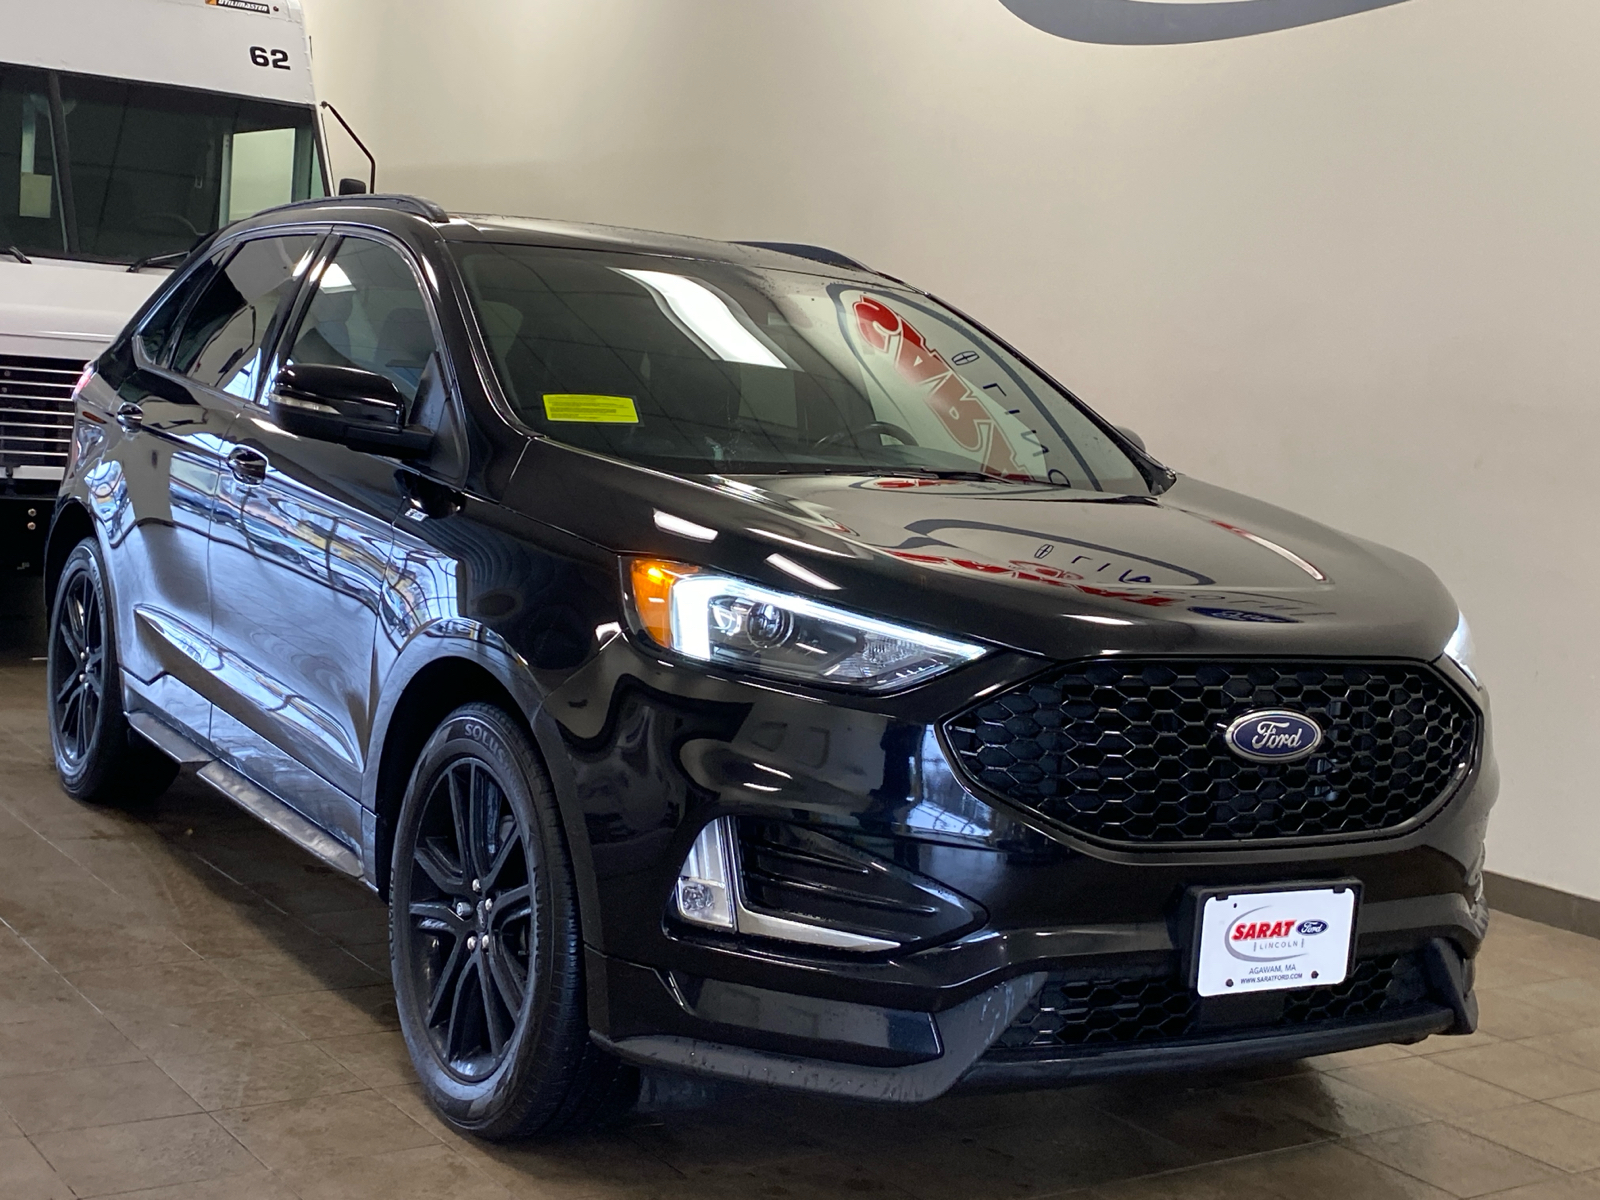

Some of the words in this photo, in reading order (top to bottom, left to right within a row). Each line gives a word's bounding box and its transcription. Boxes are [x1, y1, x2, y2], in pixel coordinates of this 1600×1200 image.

[249, 46, 291, 70] 62
[464, 723, 506, 763] SOLUS
[1251, 721, 1303, 749] Ford
[1231, 920, 1297, 942] SARAT
[1300, 921, 1324, 934] Ford
[1259, 941, 1298, 950] LINCOLN
[1240, 973, 1303, 984] WWW.SARATFORD.COM
[1249, 965, 1283, 975] AGAWAM,
[1285, 964, 1297, 972] MA
